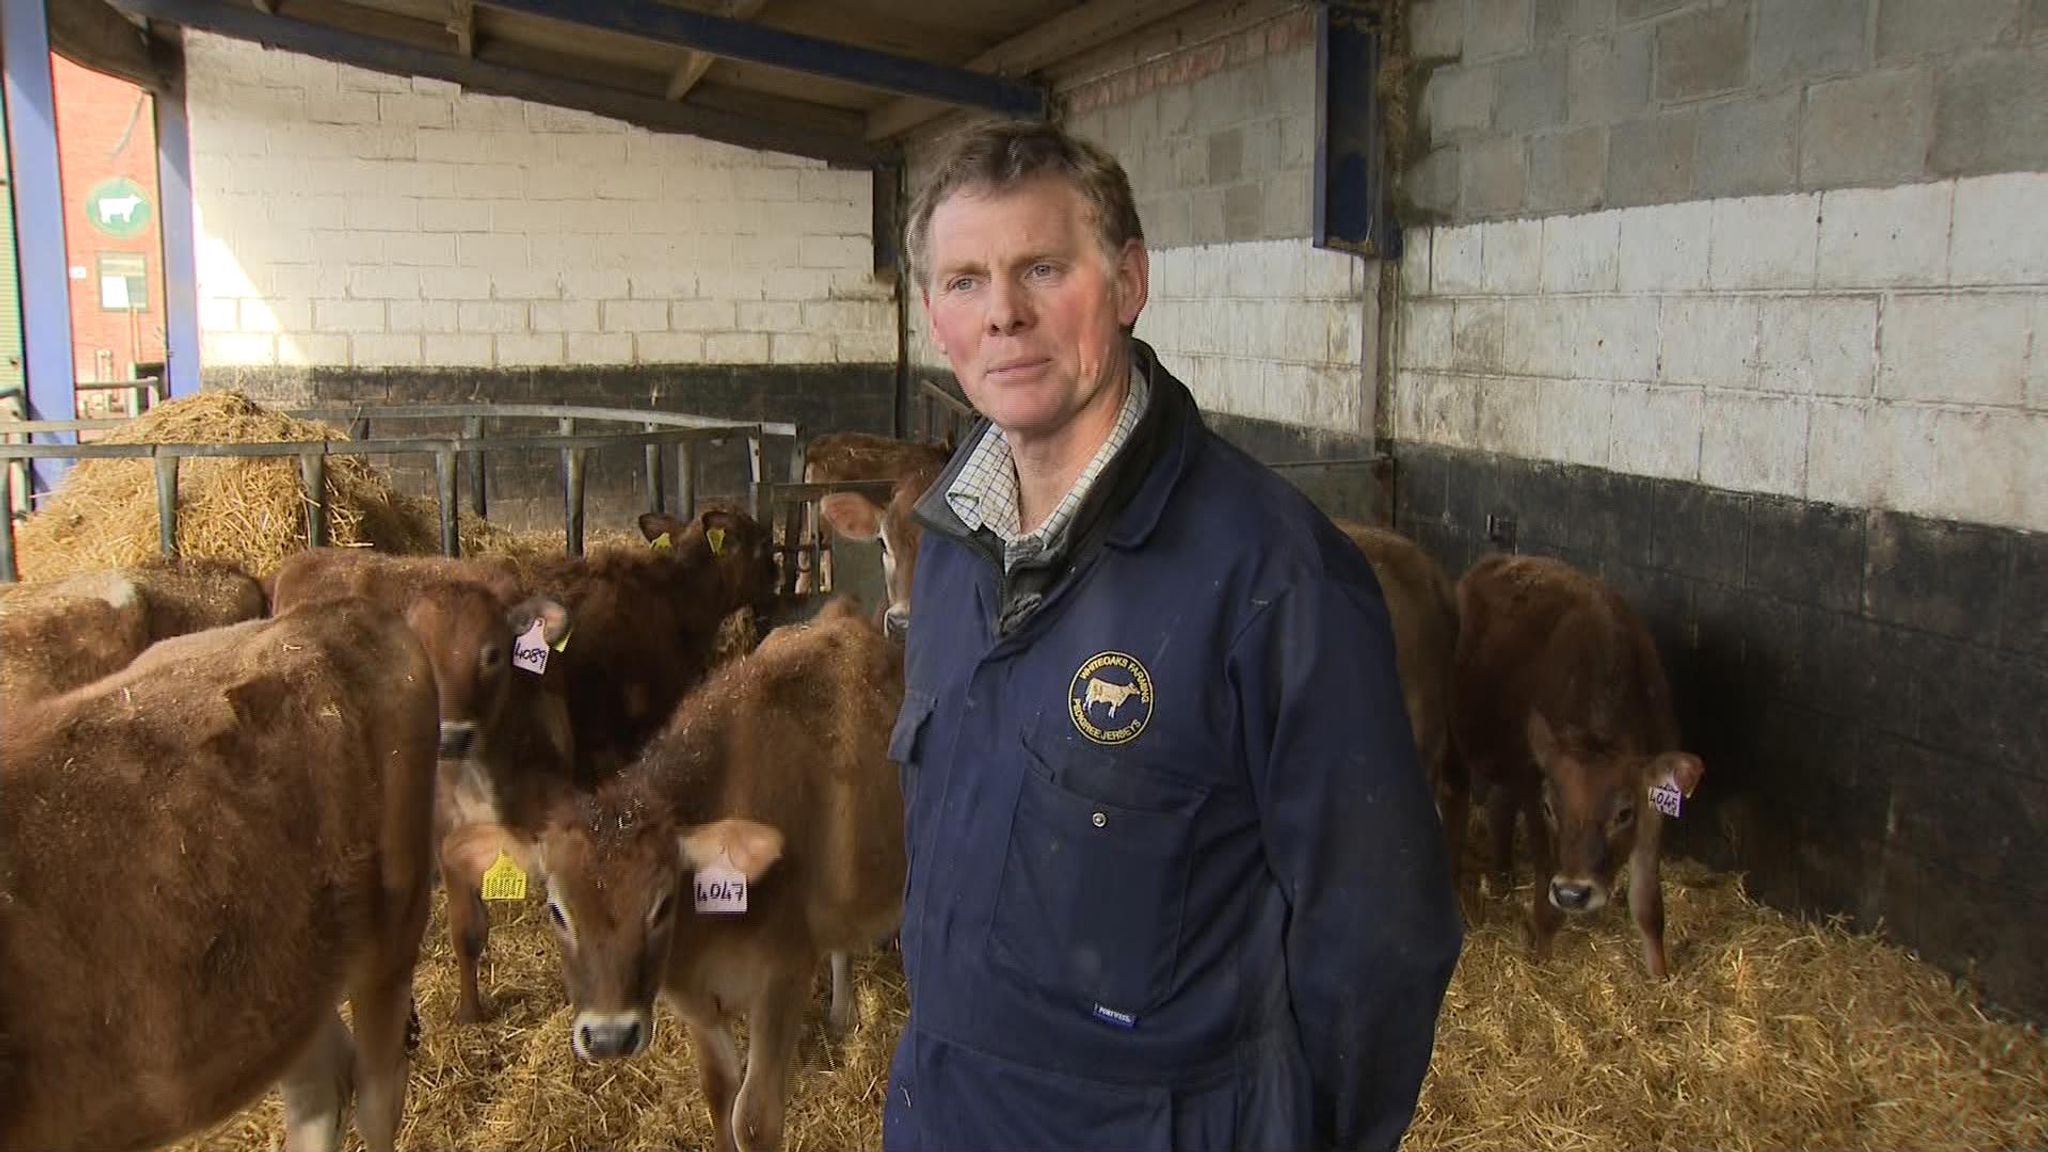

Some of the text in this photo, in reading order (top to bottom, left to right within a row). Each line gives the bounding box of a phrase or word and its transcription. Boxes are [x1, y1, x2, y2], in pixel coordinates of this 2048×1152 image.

[515, 643, 547, 670] 4089
[1080, 656, 1150, 704] WHITEOAKS FARMING
[1072, 698, 1142, 740] PEDIGREE JERSEYS
[696, 880, 744, 902] 4047
